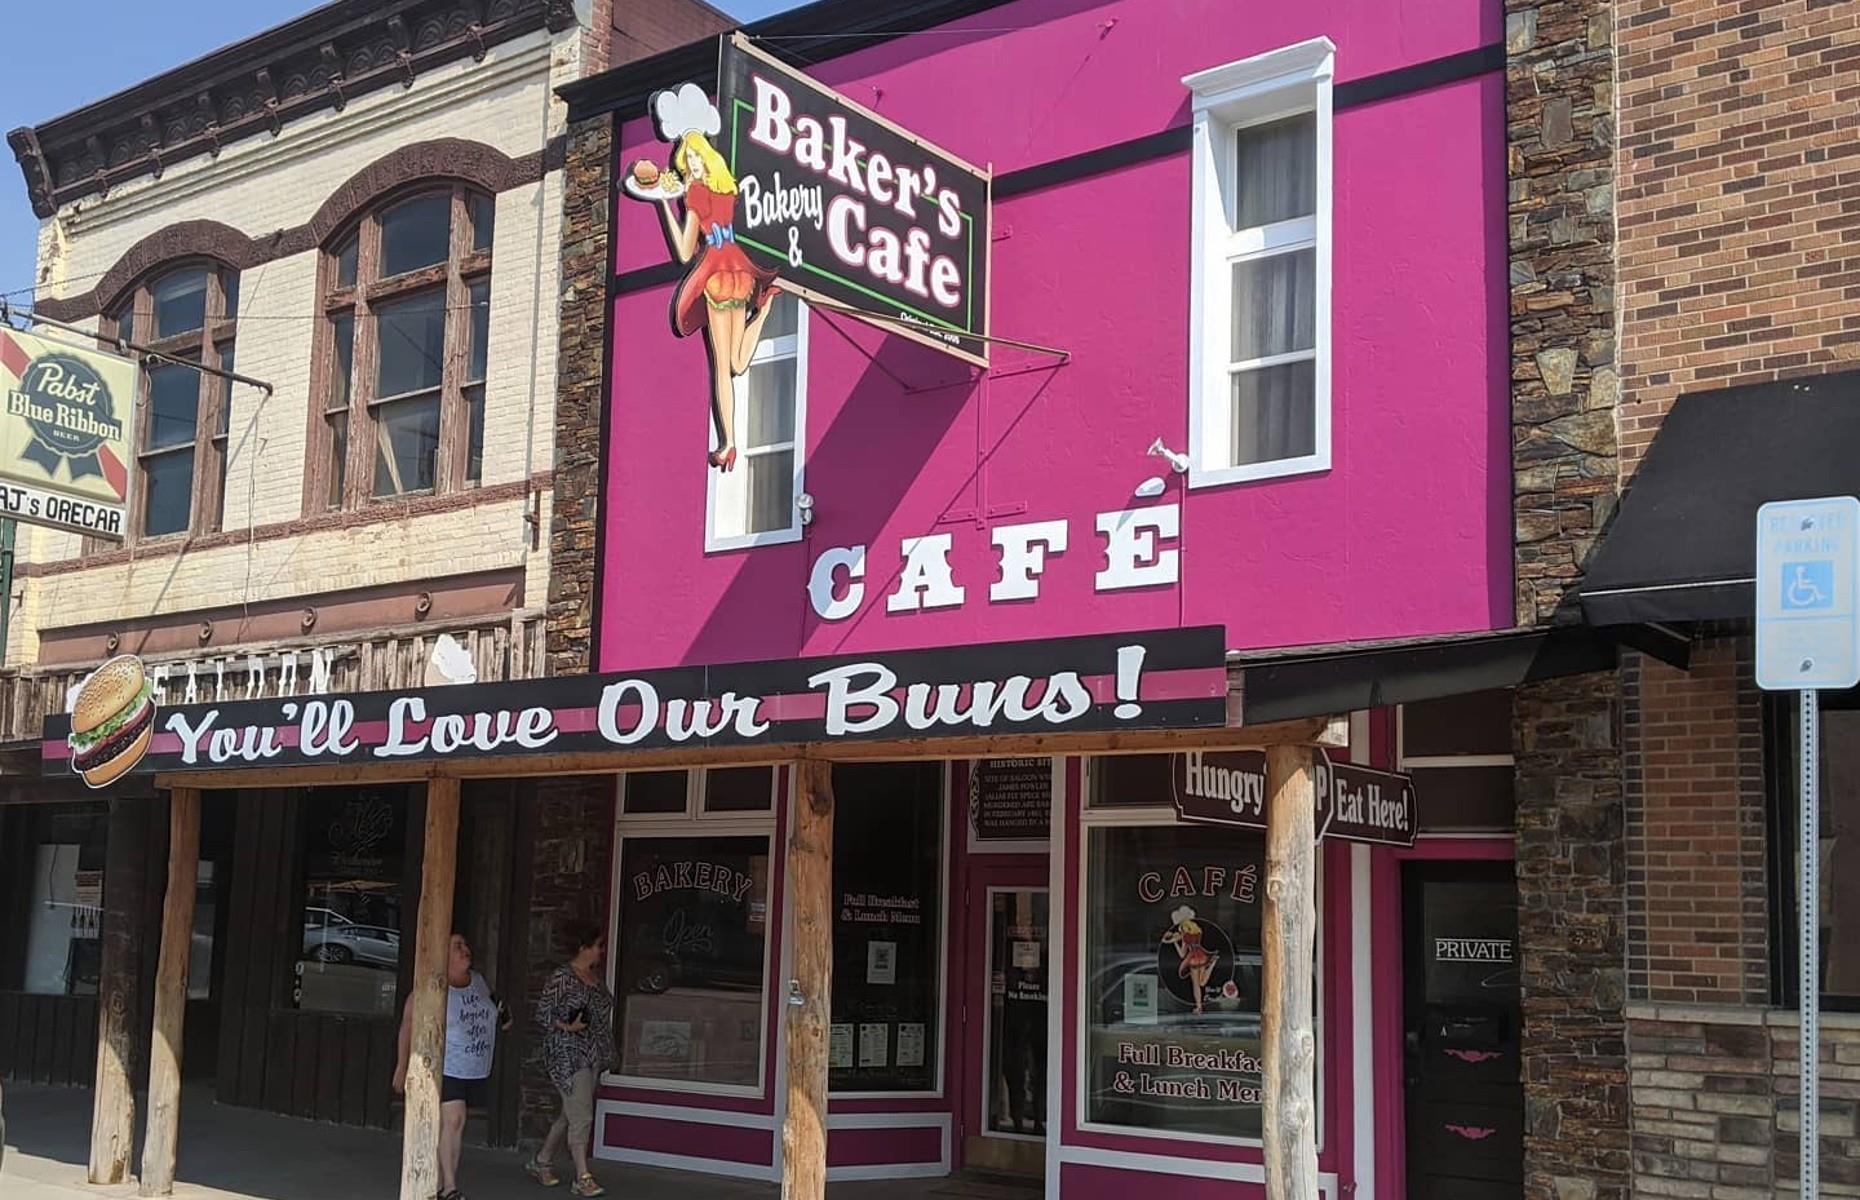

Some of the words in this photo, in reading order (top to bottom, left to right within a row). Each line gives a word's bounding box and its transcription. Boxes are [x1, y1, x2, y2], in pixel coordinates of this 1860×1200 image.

[750, 75, 961, 237] Baker's
[739, 172, 823, 230] Bakery
[788, 226, 802, 267] &
[827, 195, 960, 306] Cafe
[38, 363, 100, 405] Pabst
[10, 391, 54, 423] Blue
[56, 403, 120, 441] Ribbon
[53, 429, 80, 441] BEER
[46, 497, 121, 532] ORECAR
[807, 477, 1179, 619] CAFÉ
[165, 699, 359, 764] You'll
[374, 697, 558, 757] Love
[597, 679, 769, 744] Our
[807, 645, 1146, 735] Buns!
[990, 759, 1034, 768] HISTORIC
[1336, 779, 1363, 825] Eat
[1367, 784, 1408, 831] Here!
[633, 861, 753, 902] BAKERY
[1138, 865, 1257, 902] CAFÉ
[1436, 941, 1512, 959] PRIVATE
[1020, 991, 1048, 1002] Smokin
[1118, 1042, 1160, 1066] Full
[1168, 1045, 1262, 1073] Breakfas
[1114, 1071, 1134, 1093] &
[1141, 1073, 1210, 1099] Lunch
